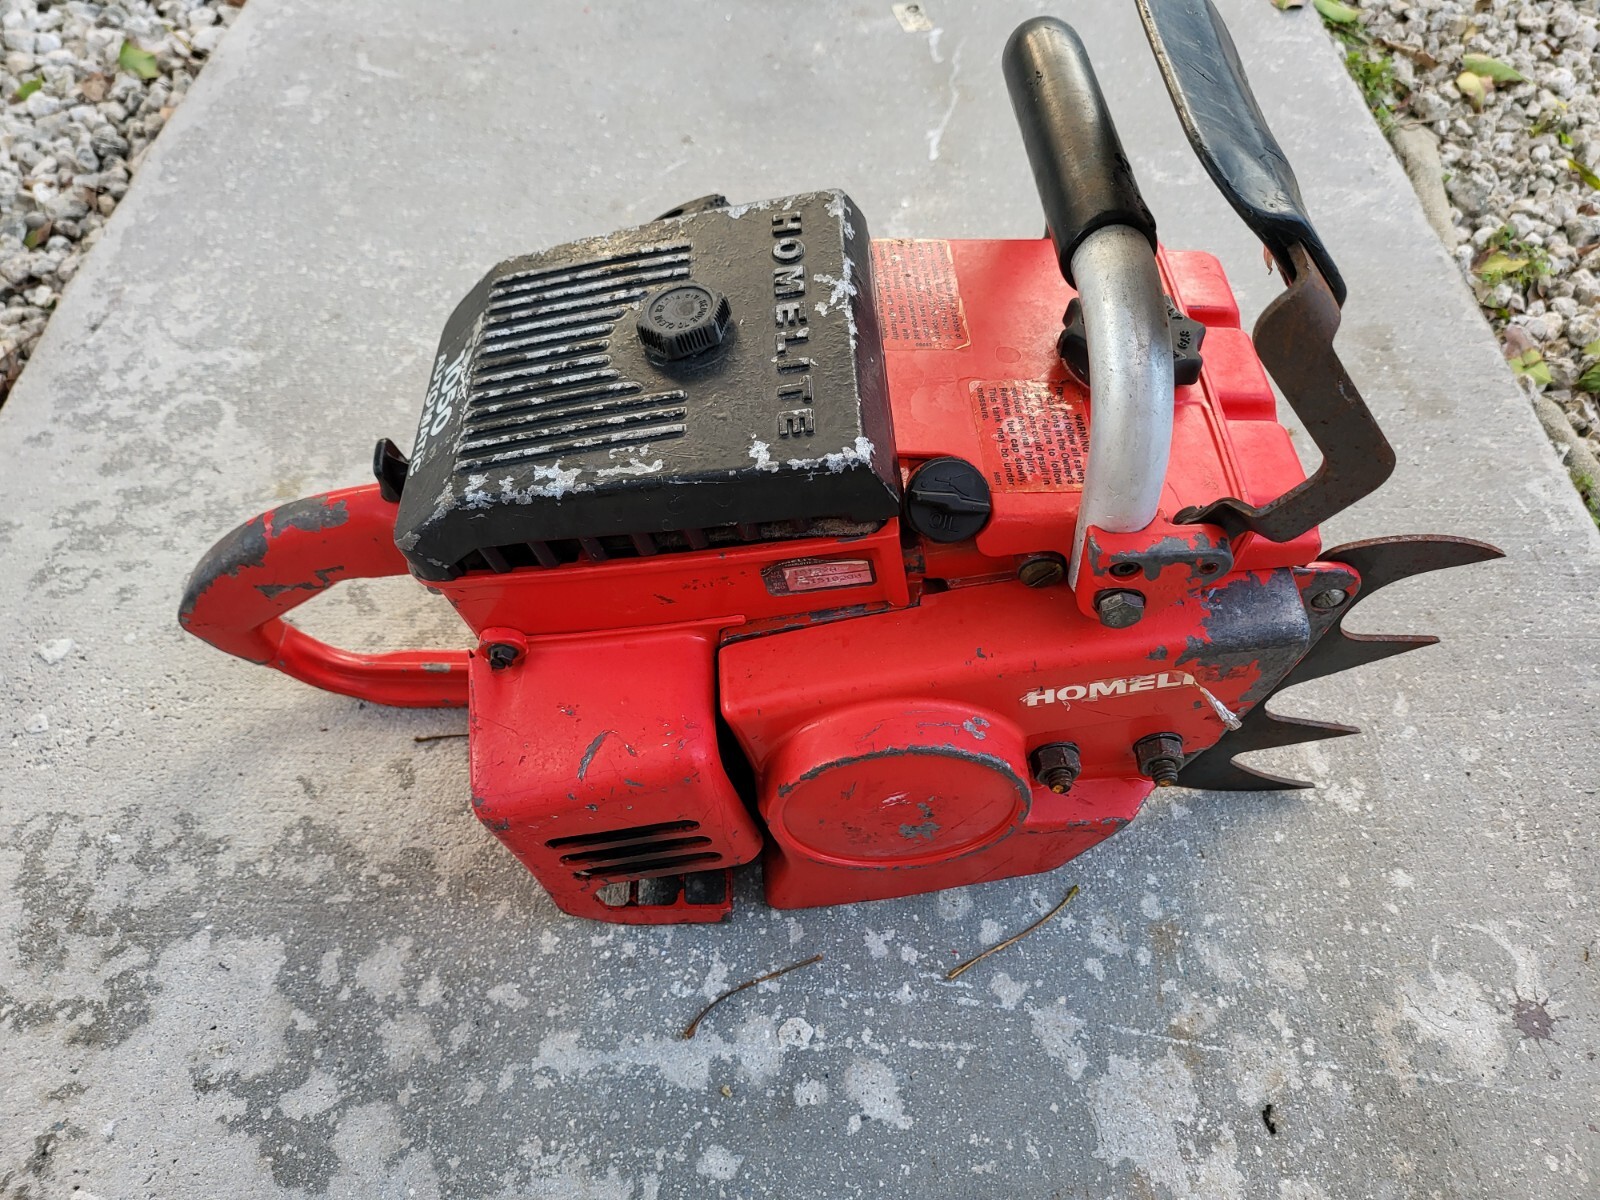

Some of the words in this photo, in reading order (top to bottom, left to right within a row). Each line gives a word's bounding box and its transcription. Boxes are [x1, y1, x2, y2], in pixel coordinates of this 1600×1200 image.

[772, 211, 815, 436] HOMELITE
[430, 349, 466, 436] 1050
[975, 387, 989, 420] pressure.
[987, 387, 998, 402] This
[998, 387, 1013, 415] Remove
[1010, 387, 1023, 413] serious
[409, 353, 448, 477] AUTOMATIC
[991, 406, 1003, 422] tank
[994, 427, 1005, 443] may
[1005, 420, 1017, 433] fuel
[1014, 415, 1032, 447] personal
[1040, 419, 1053, 444] Failure
[1064, 422, 1077, 445] follow
[1073, 413, 1091, 452] WARNING
[1009, 438, 1020, 452] cap
[1031, 431, 1044, 451] could
[1047, 448, 1056, 456] to
[1056, 438, 1067, 450] the
[1070, 447, 1081, 456] all
[1003, 462, 1016, 485] under
[1012, 457, 1028, 485] slowly.
[1022, 451, 1037, 475] injury.
[1036, 453, 1049, 474] result
[1050, 460, 1064, 484] follow
[1060, 452, 1076, 484] Owner's
